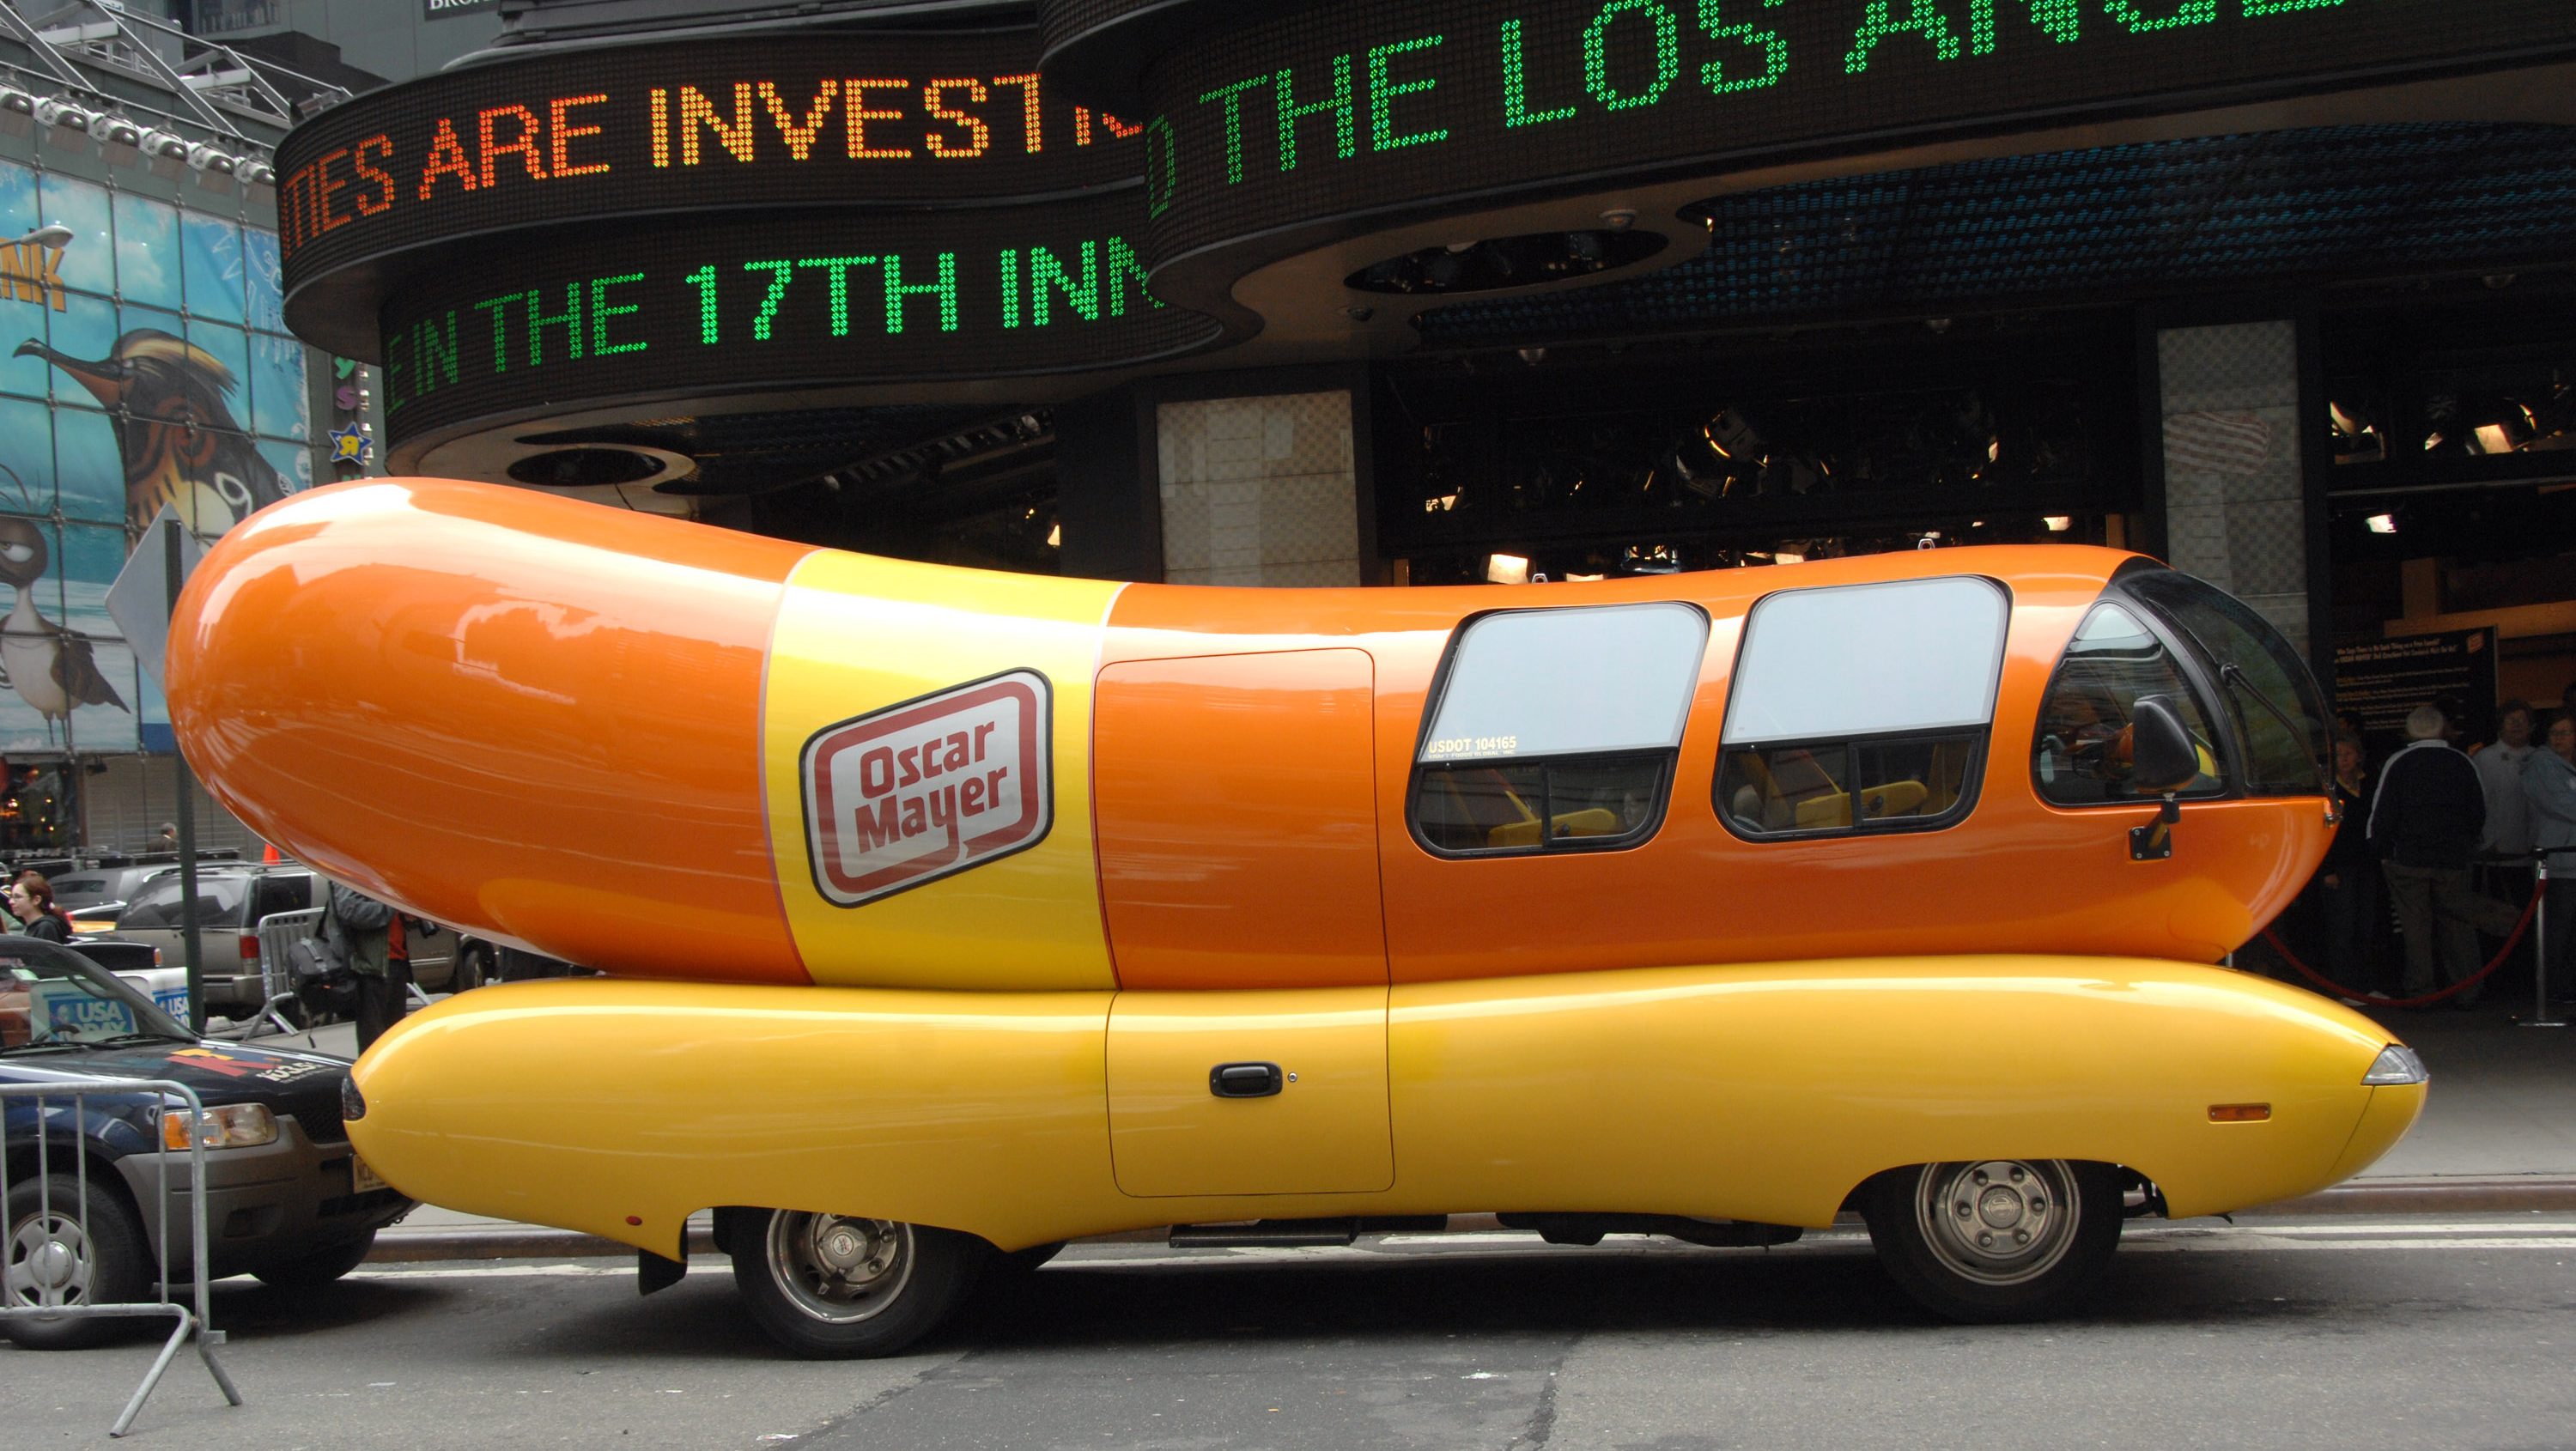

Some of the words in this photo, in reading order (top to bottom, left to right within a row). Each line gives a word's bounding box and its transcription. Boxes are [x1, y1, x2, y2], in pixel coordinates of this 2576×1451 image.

[1199, 35, 1448, 185] THE
[1502, 0, 1788, 128] LOS
[419, 94, 611, 201] ARE
[414, 310, 459, 397] IN
[474, 272, 647, 373] THE
[686, 252, 958, 344] 17TH
[860, 720, 994, 799] Oscar
[1429, 738, 1472, 754] USDOT
[1475, 736, 1516, 750] 104165
[854, 766, 1007, 855] Mayer
[76, 1001, 125, 1023] USA
